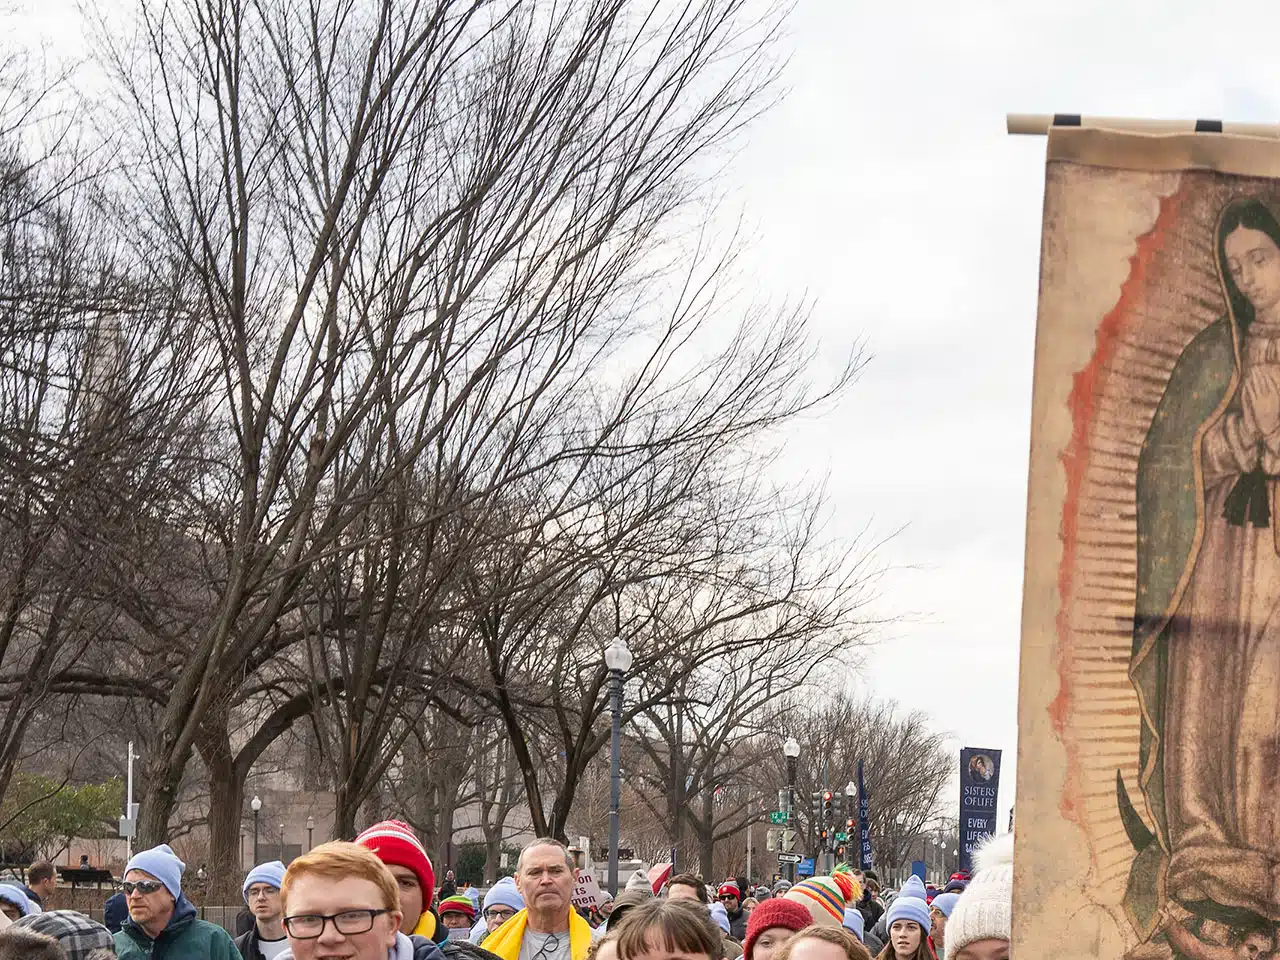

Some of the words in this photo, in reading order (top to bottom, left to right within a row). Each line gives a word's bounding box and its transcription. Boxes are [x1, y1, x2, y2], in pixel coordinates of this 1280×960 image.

[964, 786, 995, 797] SISTERS
[964, 797, 977, 806] OF
[977, 798, 994, 807] LIFE
[968, 818, 988, 829] EVERY
[578, 875, 592, 884] on
[575, 886, 586, 896] ts
[571, 895, 596, 905] men
